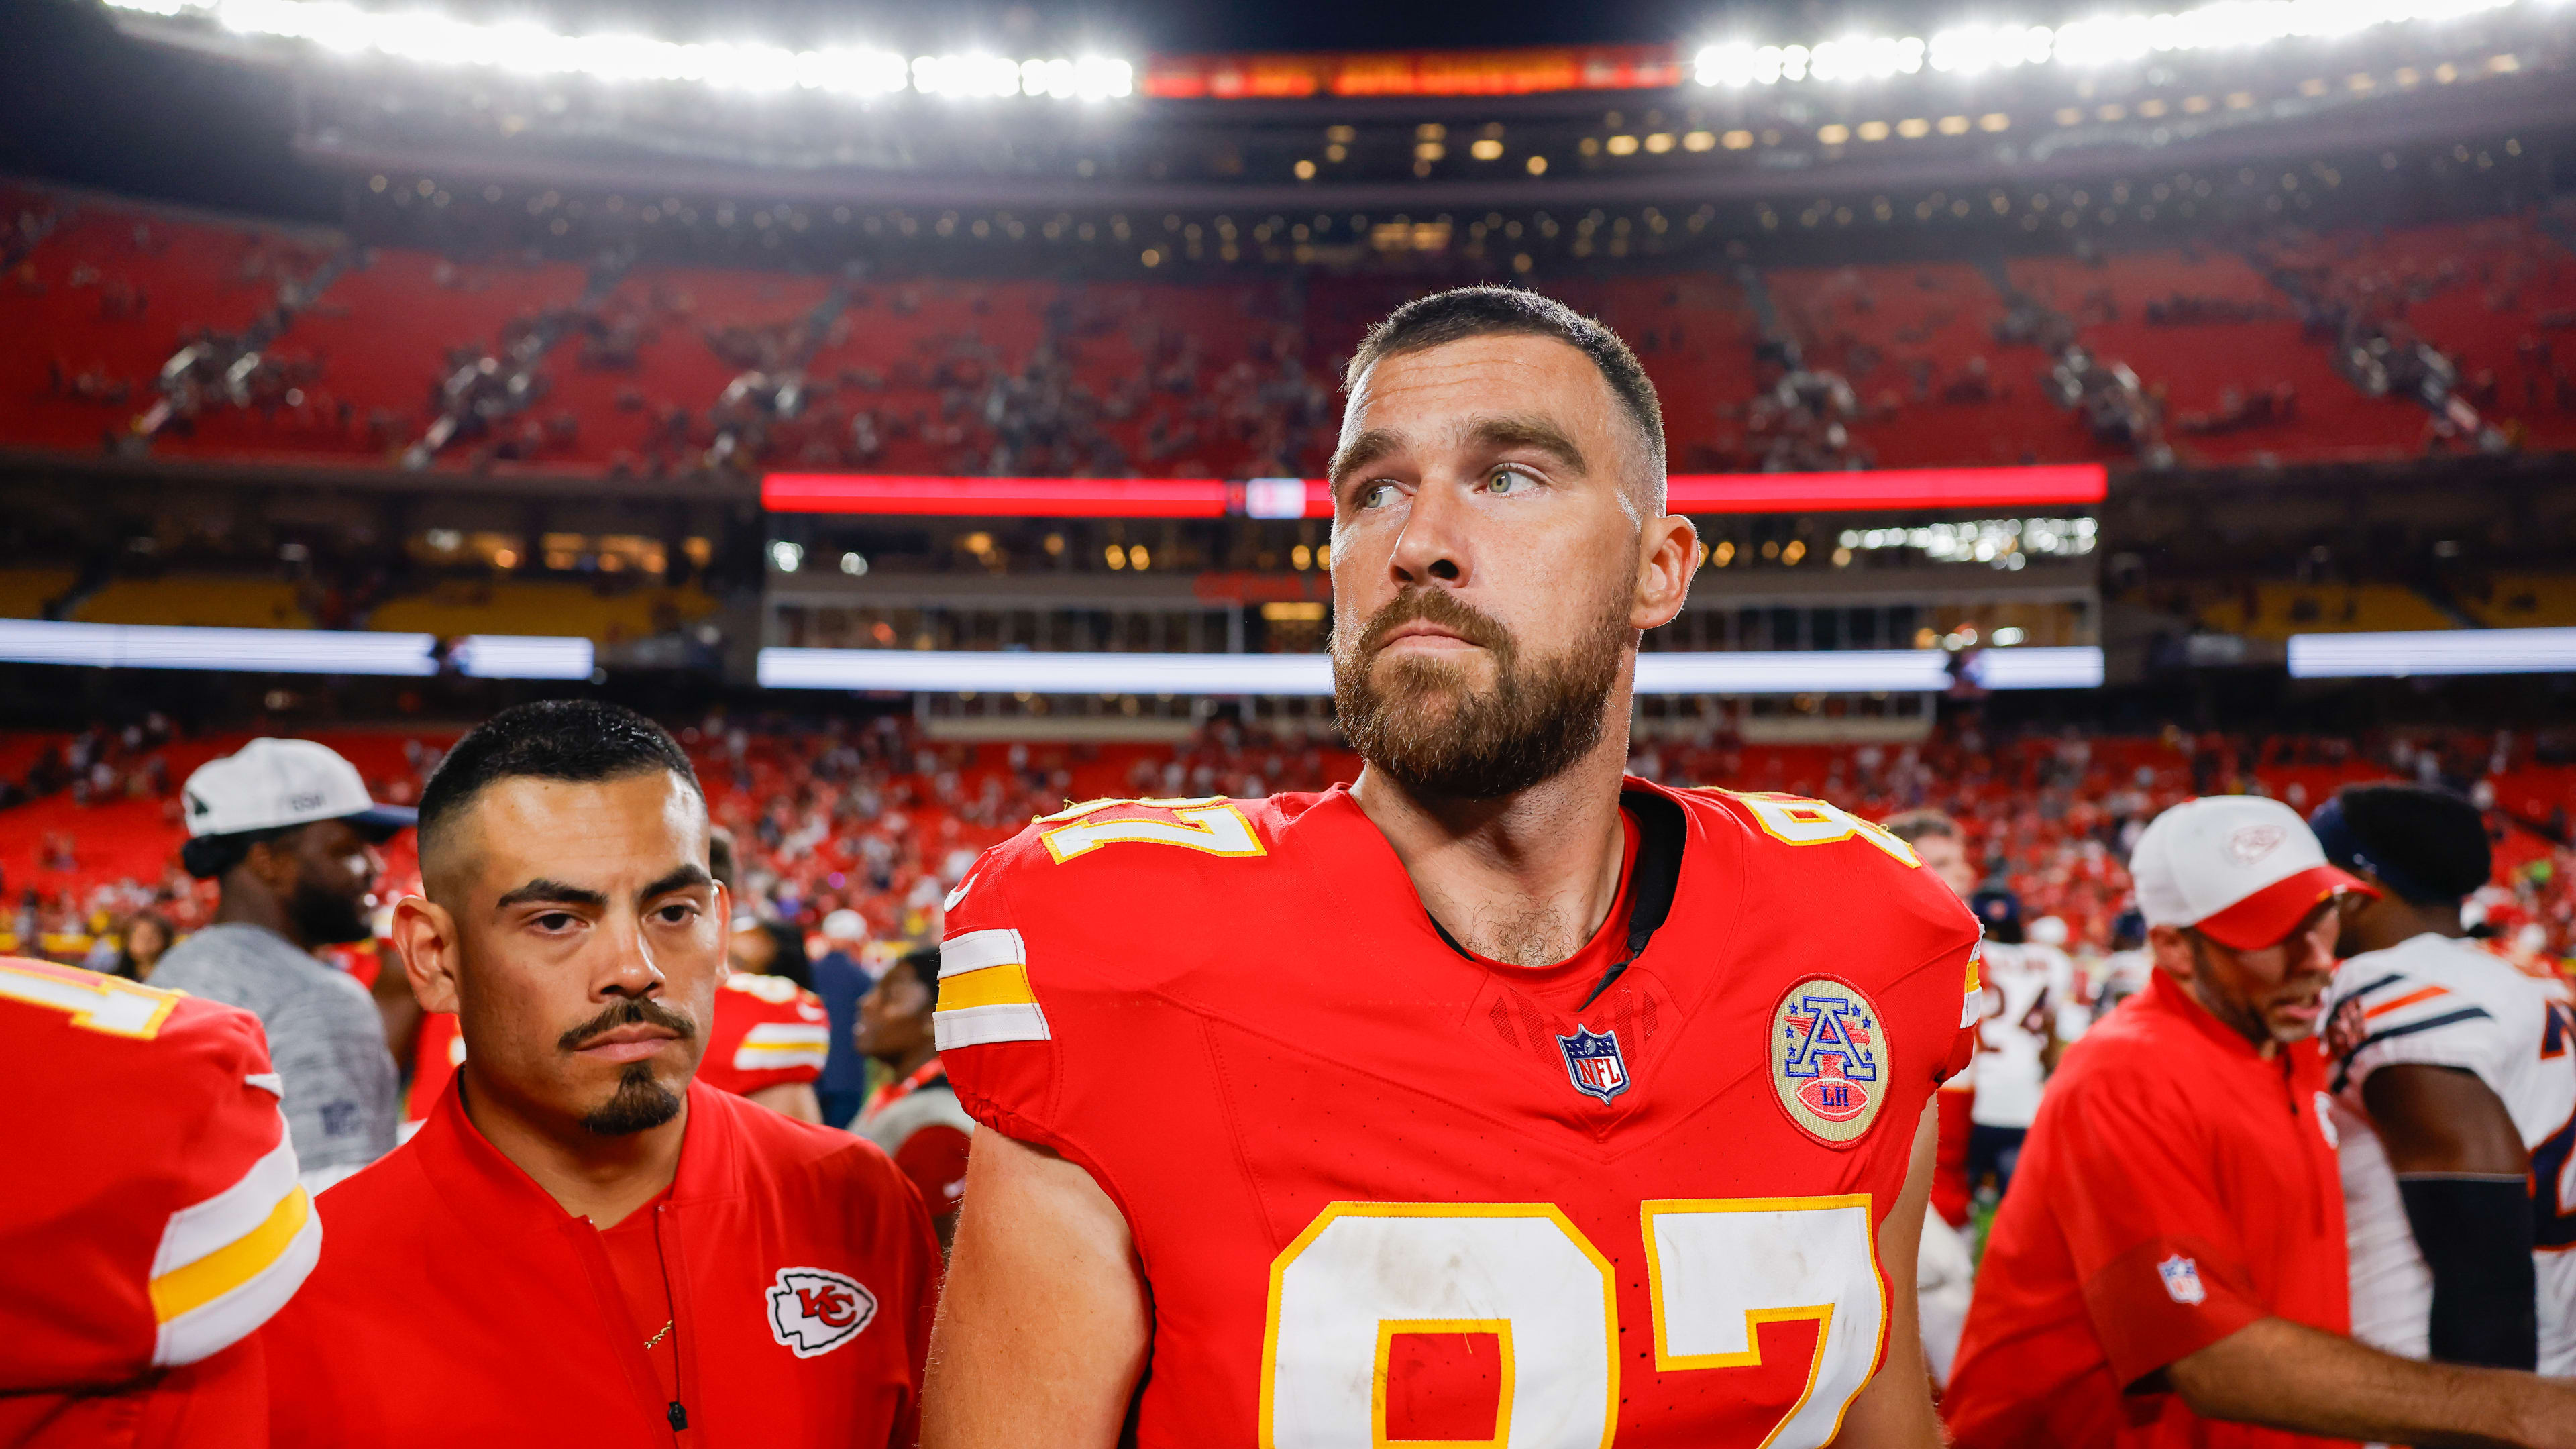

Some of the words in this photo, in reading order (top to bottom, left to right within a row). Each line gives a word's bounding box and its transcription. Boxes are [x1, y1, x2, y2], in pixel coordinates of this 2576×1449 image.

[1785, 995, 1877, 1082] A
[1576, 1057, 1621, 1088] NFL
[1819, 1085, 1849, 1107] LH
[795, 1285, 857, 1328] KC
